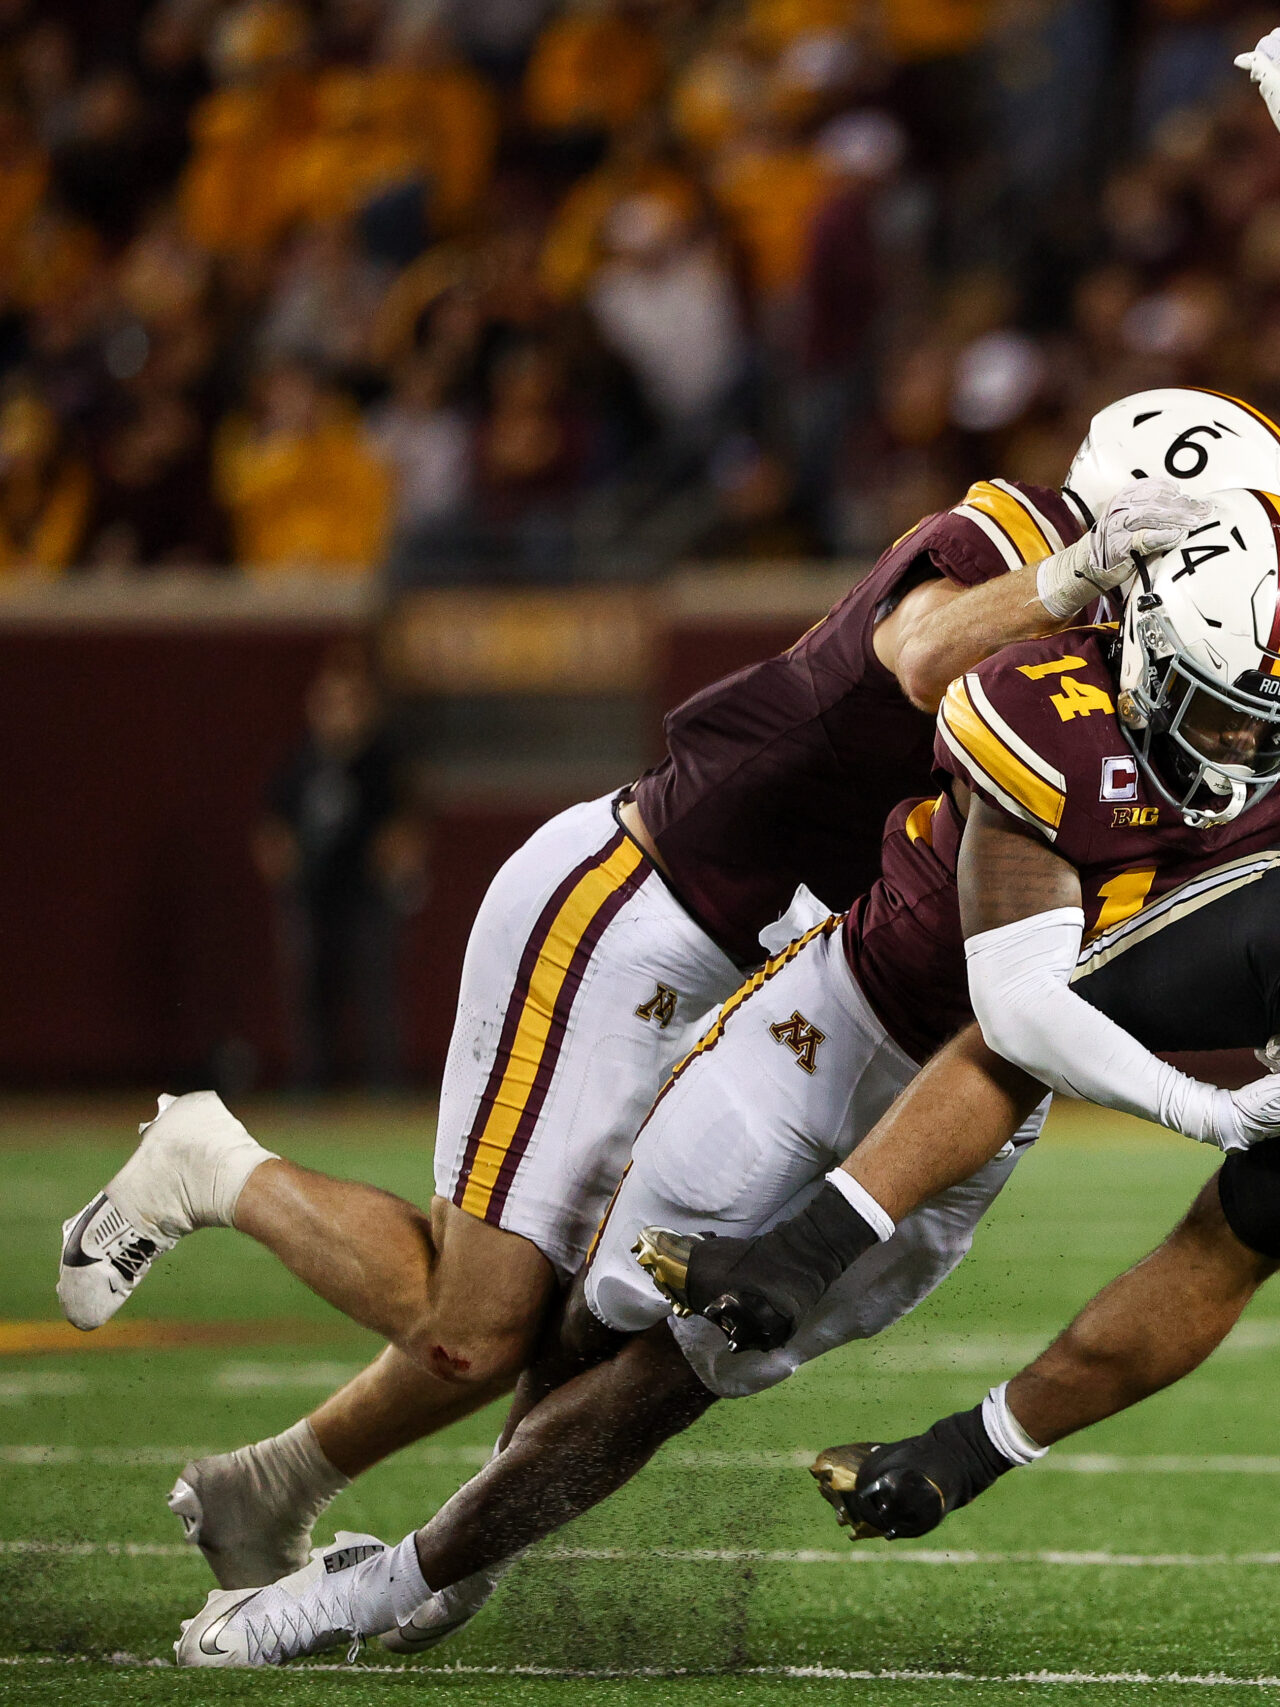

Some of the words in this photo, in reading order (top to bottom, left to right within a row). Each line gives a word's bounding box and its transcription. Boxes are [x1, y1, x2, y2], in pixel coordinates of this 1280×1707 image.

[1164, 425, 1222, 479] 6
[1015, 655, 1116, 722] 14
[1102, 758, 1136, 799] C
[768, 1010, 826, 1075] M
[323, 1545, 385, 1574] NIKE
